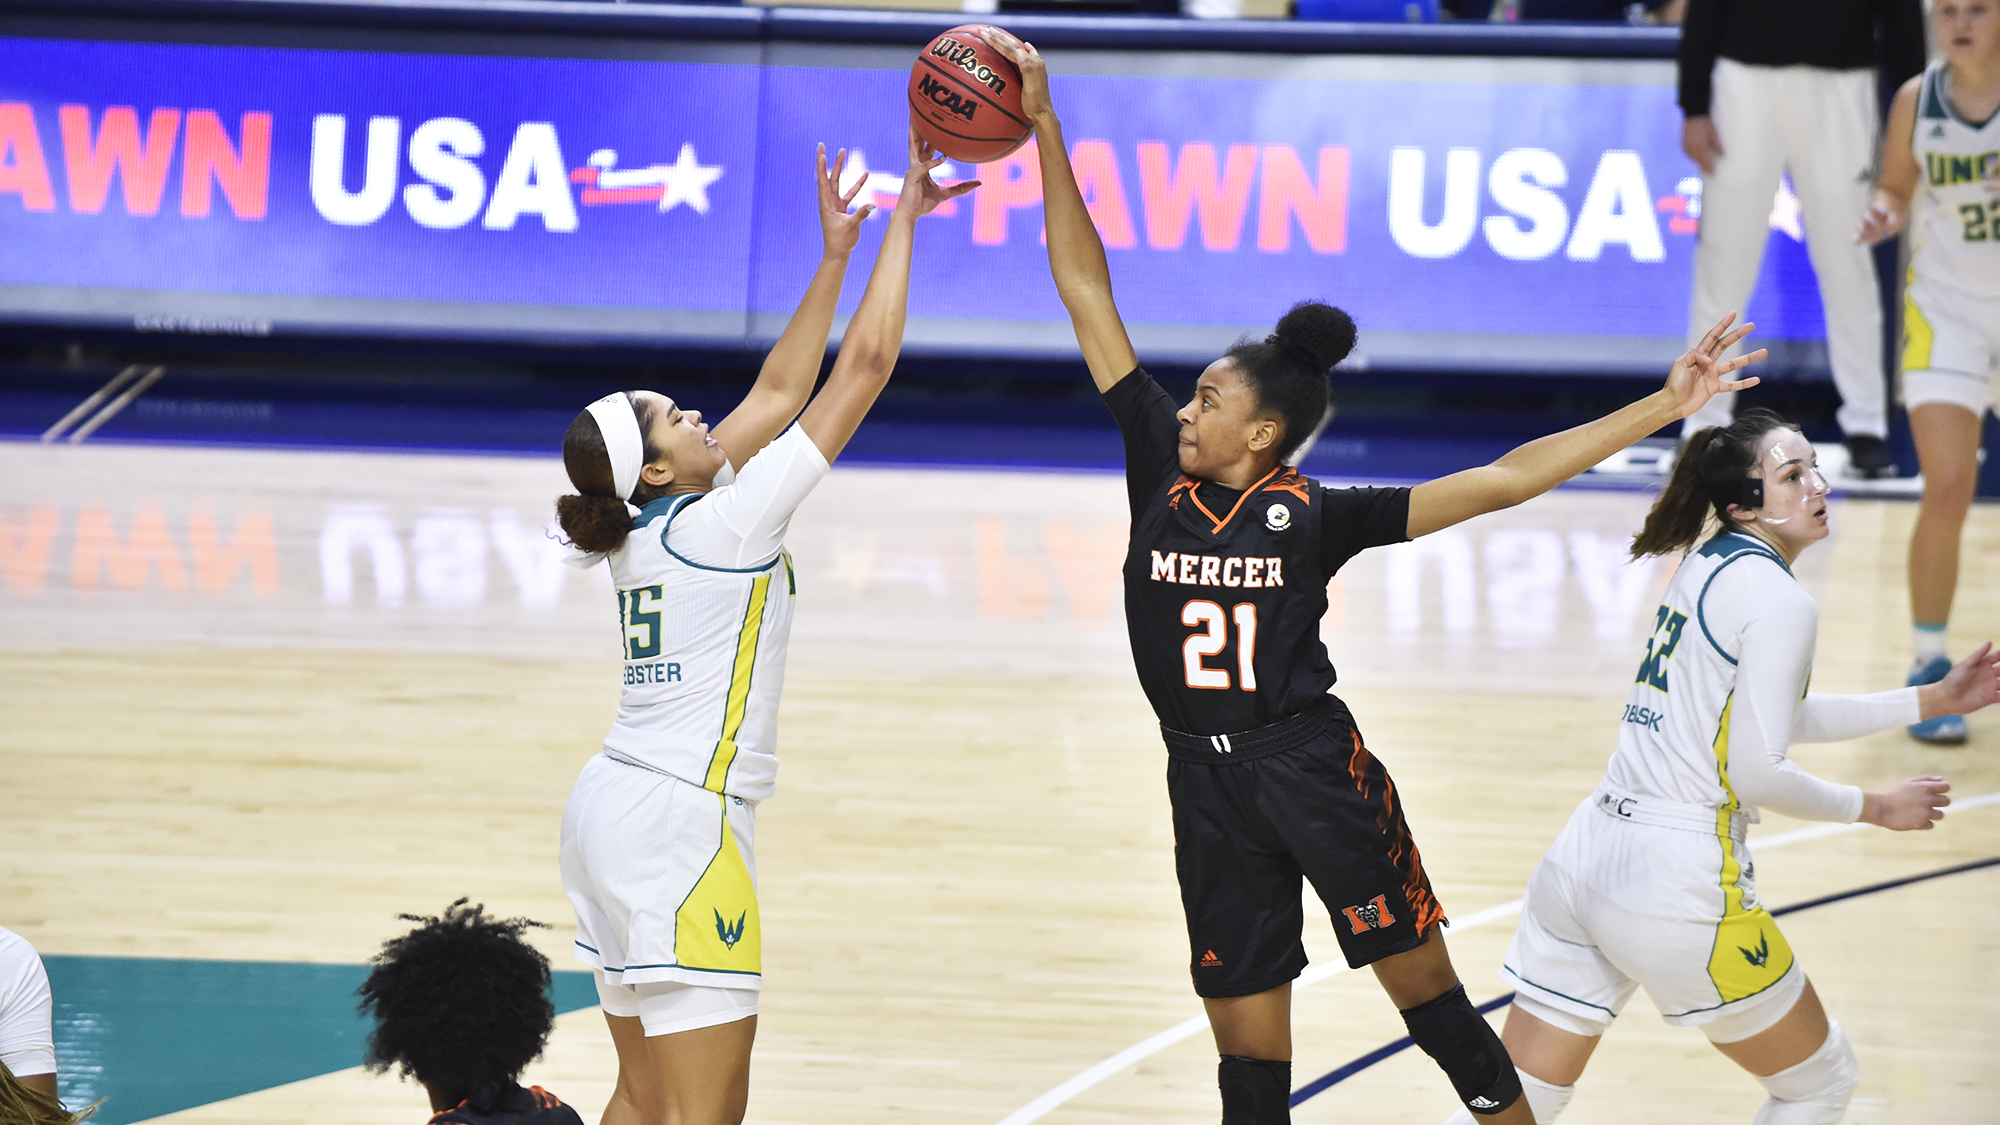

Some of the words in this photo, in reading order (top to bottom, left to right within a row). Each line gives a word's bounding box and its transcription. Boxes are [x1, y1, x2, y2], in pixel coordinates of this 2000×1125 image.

[917, 72, 978, 121] NCAA
[930, 37, 1007, 97] Wilson
[310, 114, 579, 233] USA
[972, 138, 1350, 254] PAWN
[1388, 145, 1667, 263] USA
[1151, 549, 1284, 588] MERCER
[1181, 599, 1257, 692] 21
